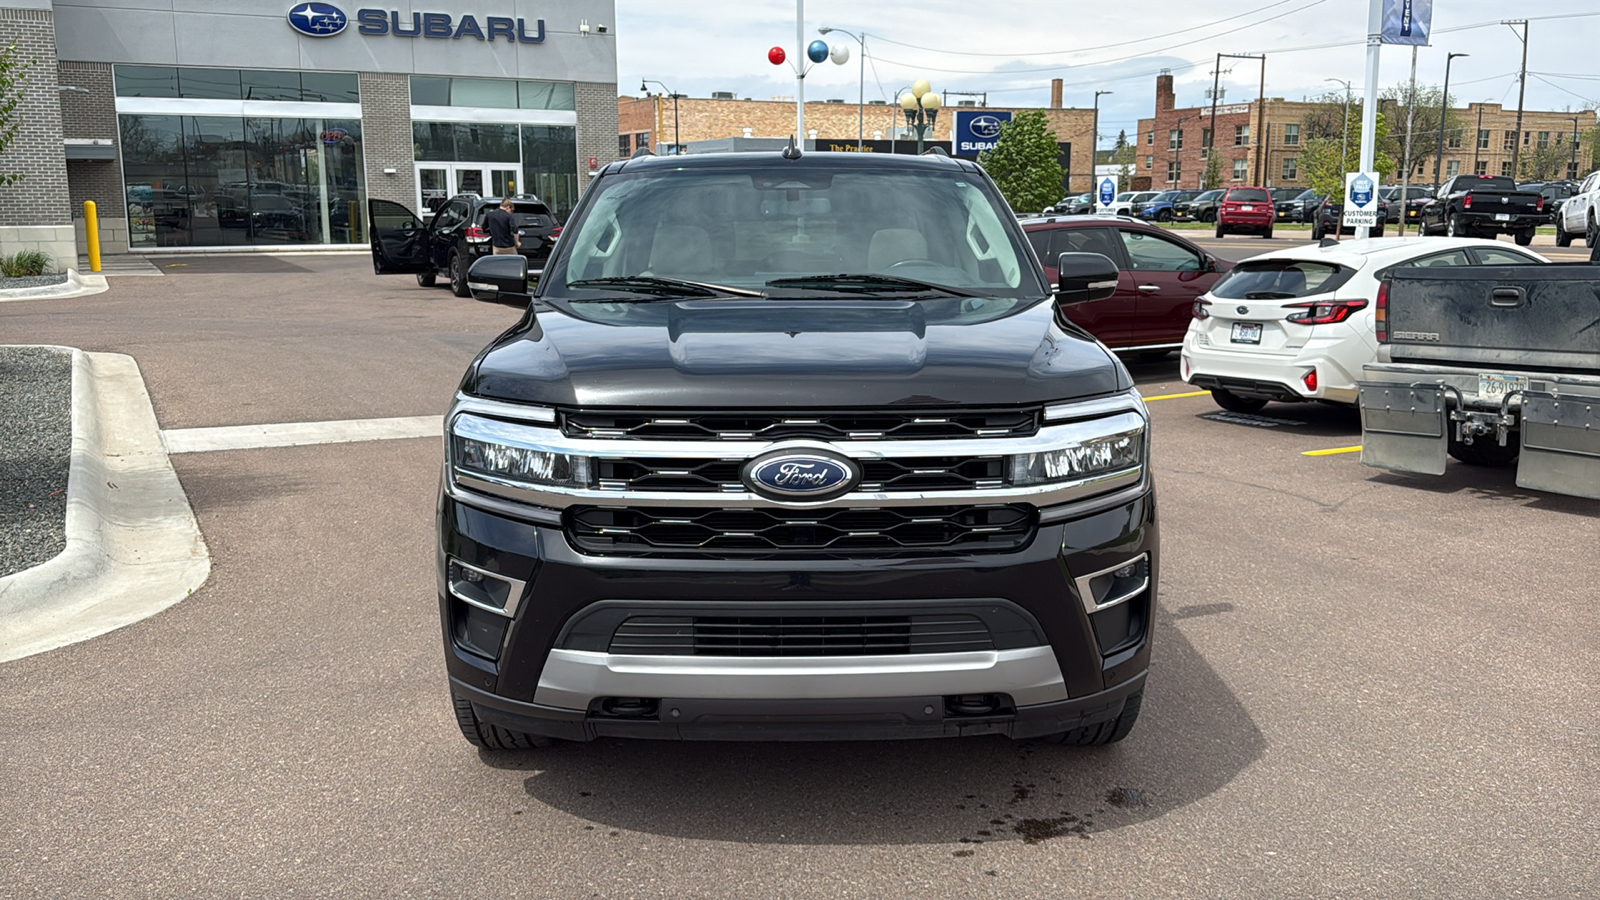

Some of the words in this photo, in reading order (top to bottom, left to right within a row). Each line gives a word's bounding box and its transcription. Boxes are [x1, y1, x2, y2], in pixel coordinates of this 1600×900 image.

[1403, 0, 1411, 31] VENT
[357, 8, 546, 44] SUBARU
[829, 144, 844, 152] The
[845, 144, 874, 153] Pratice
[961, 141, 998, 151] SUBA
[1393, 331, 1440, 341] SIERRA
[774, 462, 828, 485] Ford
